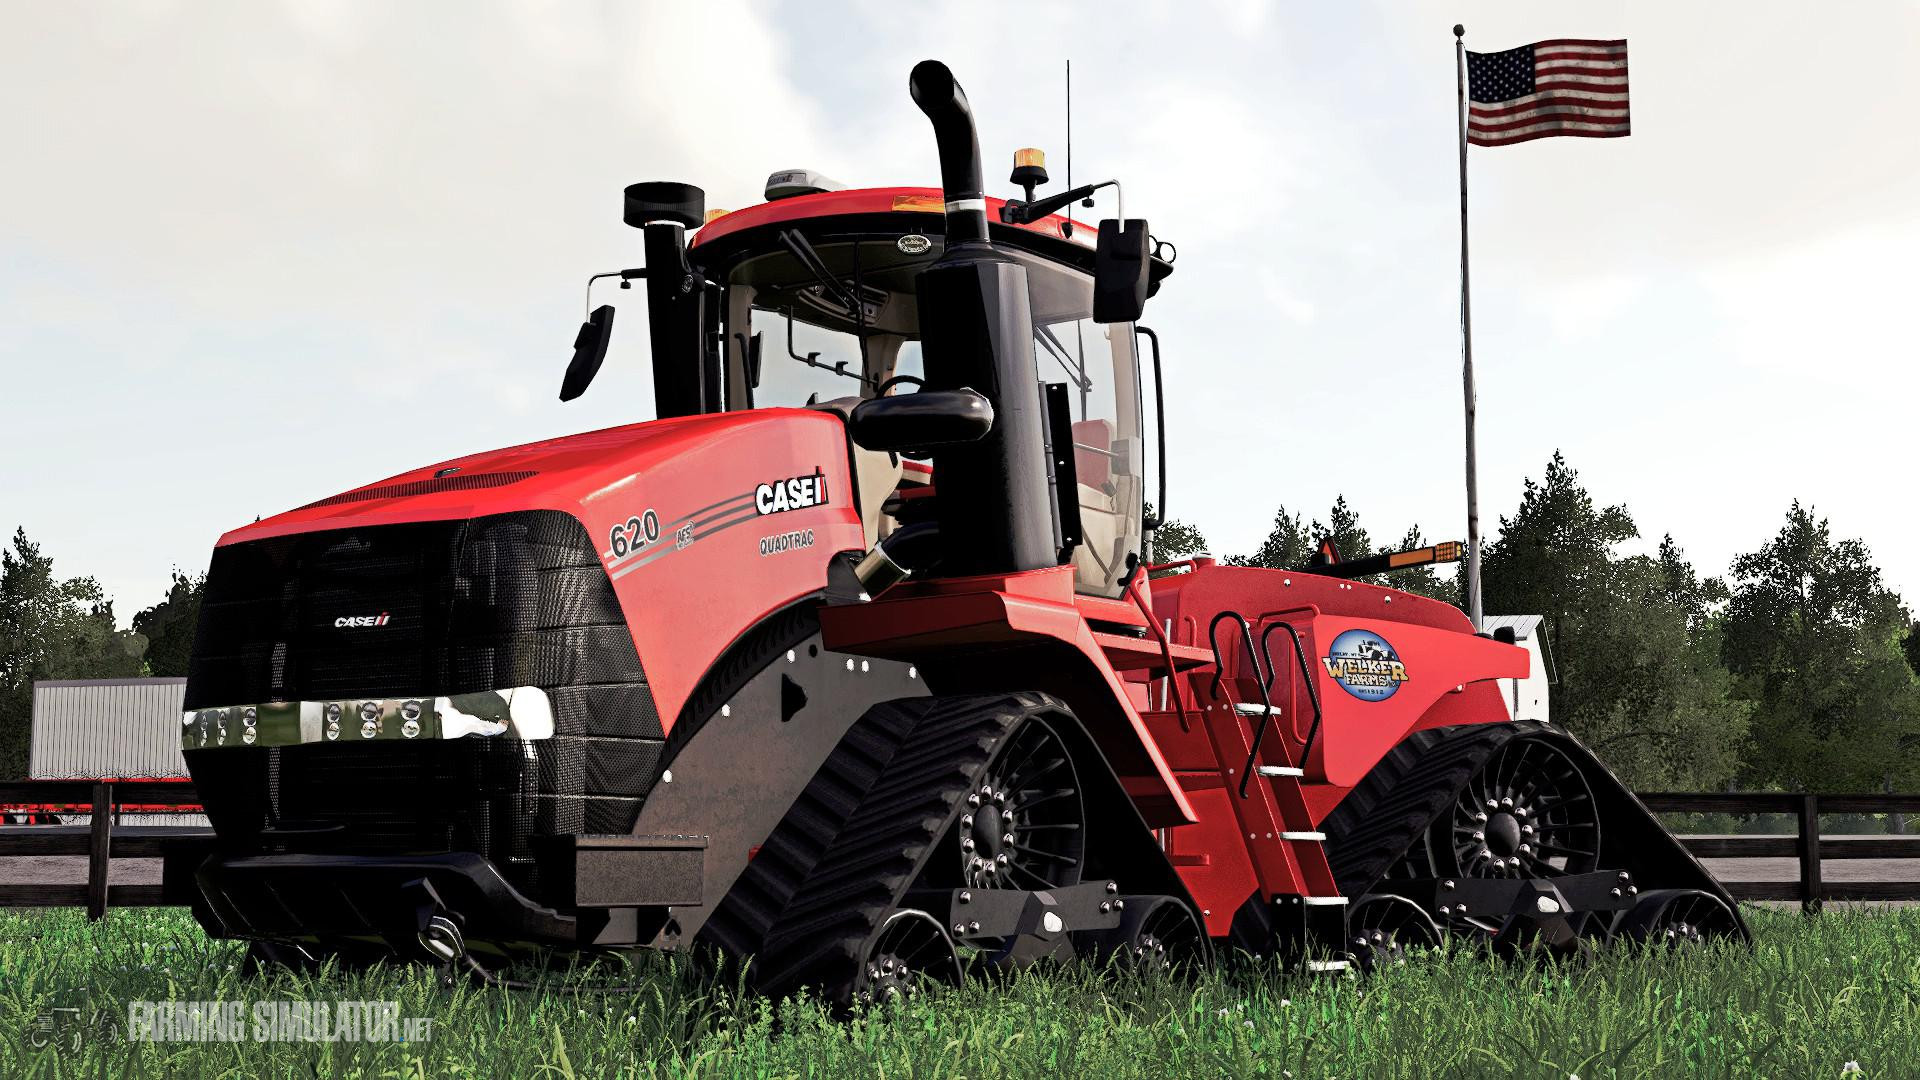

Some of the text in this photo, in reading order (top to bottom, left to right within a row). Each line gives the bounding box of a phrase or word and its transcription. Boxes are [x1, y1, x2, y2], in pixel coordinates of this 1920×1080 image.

[609, 509, 660, 558] 620
[759, 529, 815, 557] QUADTRAC
[1322, 657, 1409, 681] WELKER
[1346, 673, 1387, 687] FARMS
